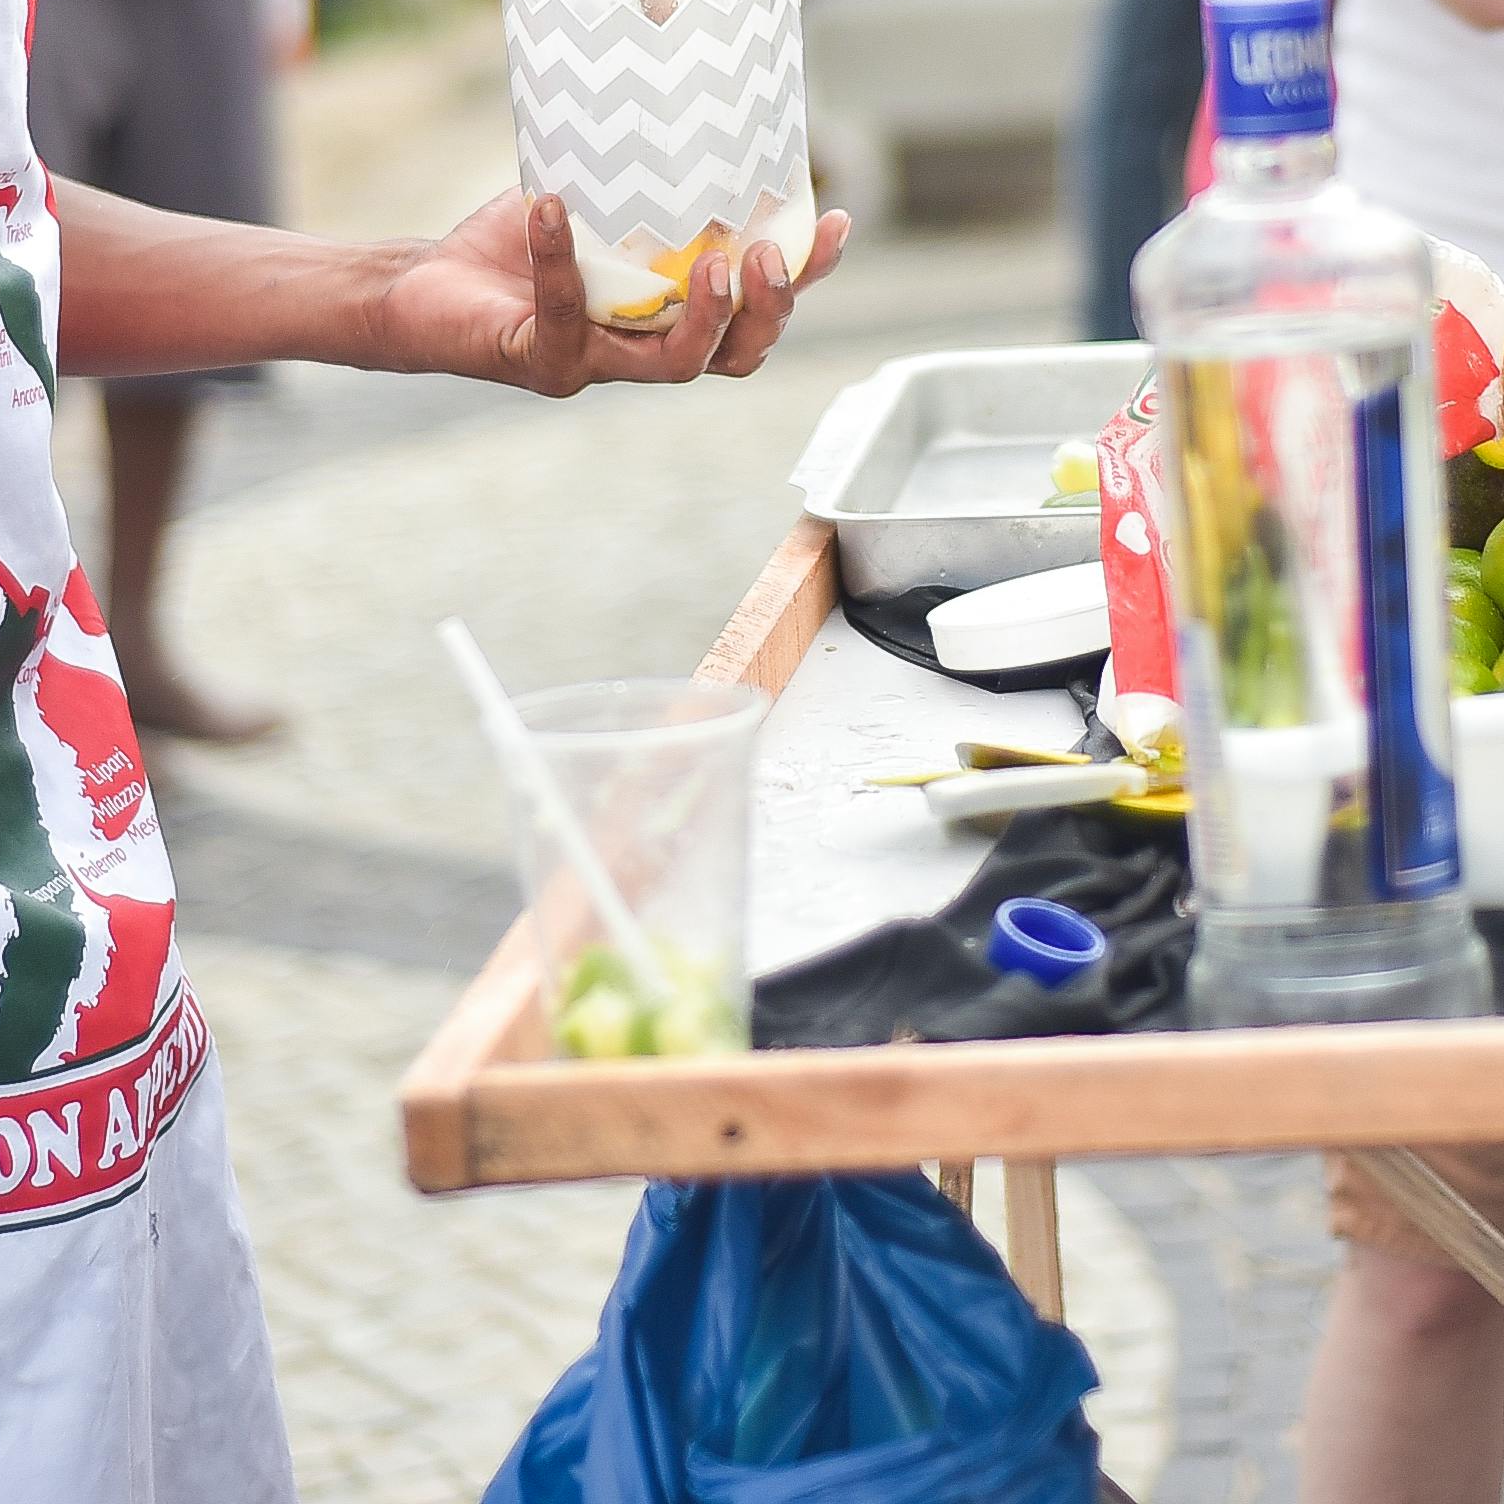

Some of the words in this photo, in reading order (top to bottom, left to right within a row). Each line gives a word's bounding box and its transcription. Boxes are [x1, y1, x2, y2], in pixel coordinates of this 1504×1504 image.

[11, 385, 45, 409] Ancona
[85, 745, 133, 786] Lipari
[93, 781, 144, 824] Milazzo
[78, 847, 127, 883] Palermo
